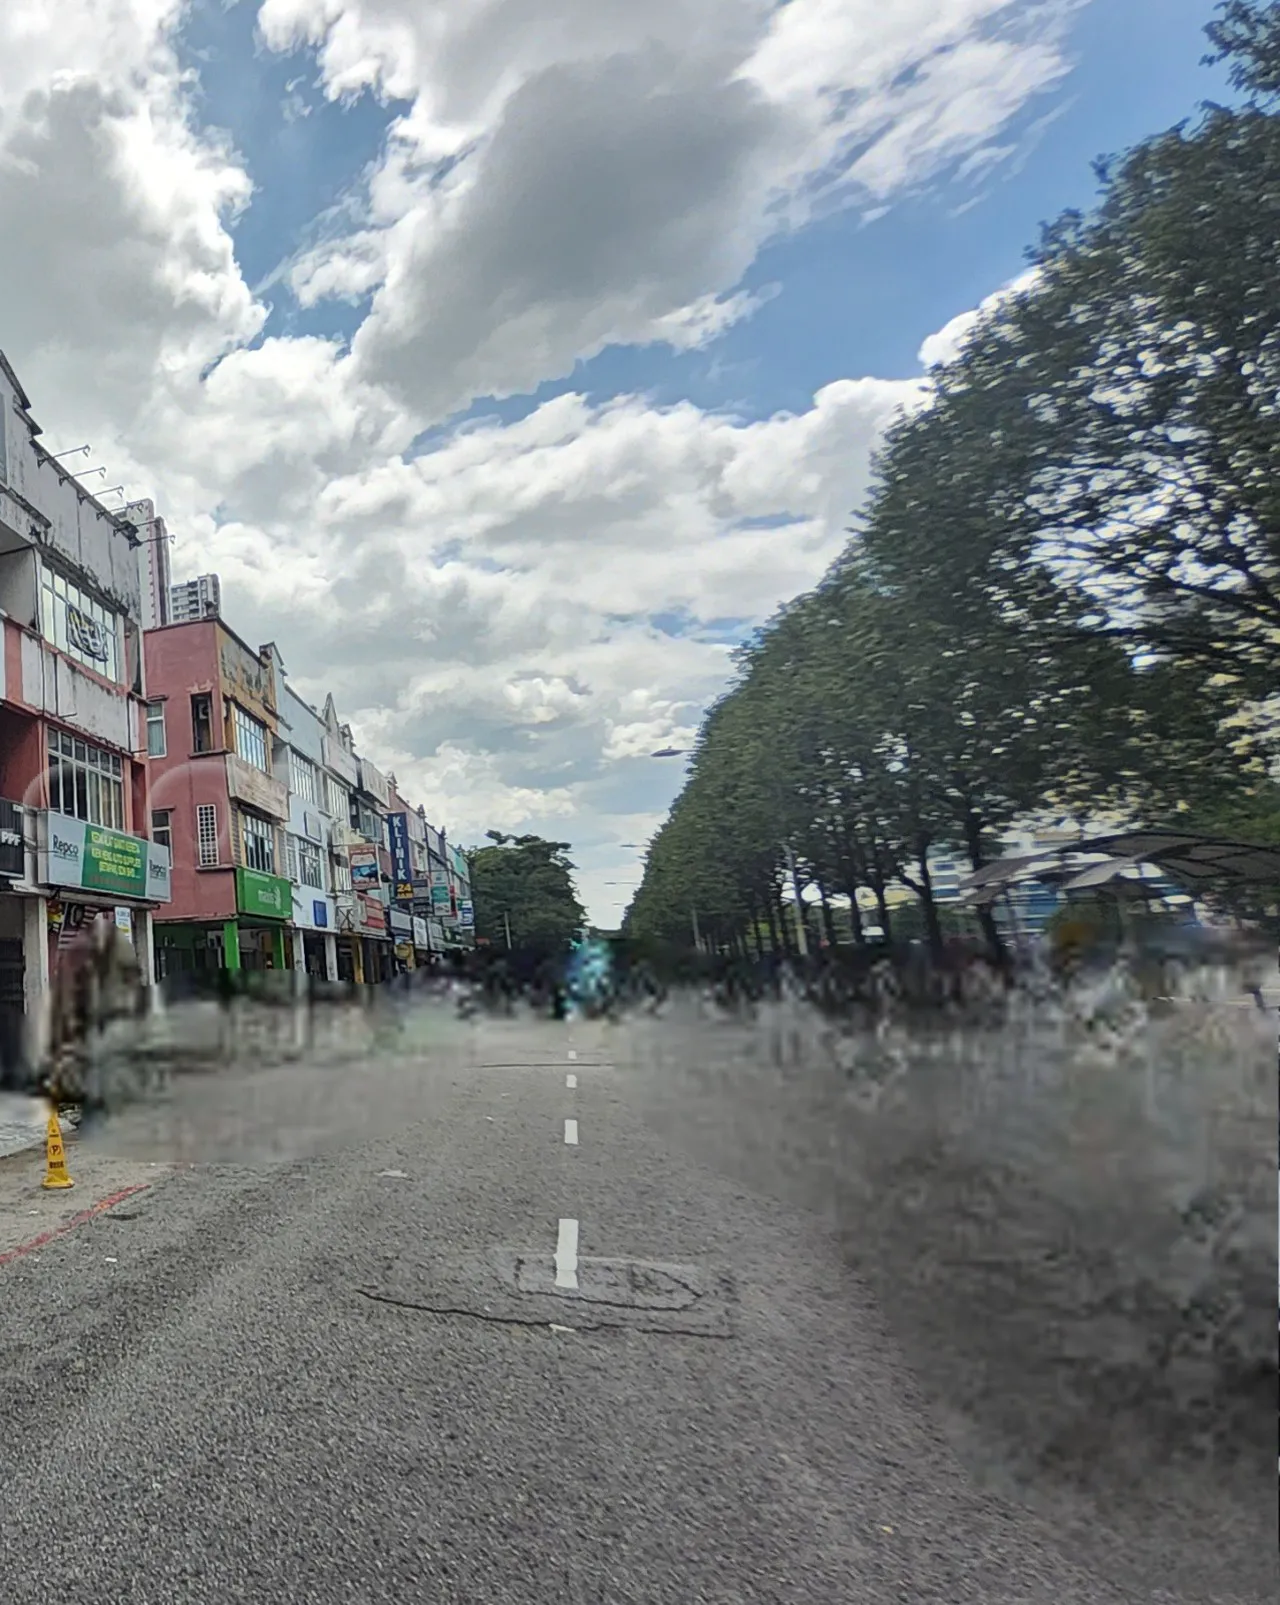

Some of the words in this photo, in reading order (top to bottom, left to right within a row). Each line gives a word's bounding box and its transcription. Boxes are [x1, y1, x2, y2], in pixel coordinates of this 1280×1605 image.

[1, 830, 21, 846] PPF
[53, 834, 79, 856] Repco
[393, 816, 407, 880] KLINIK
